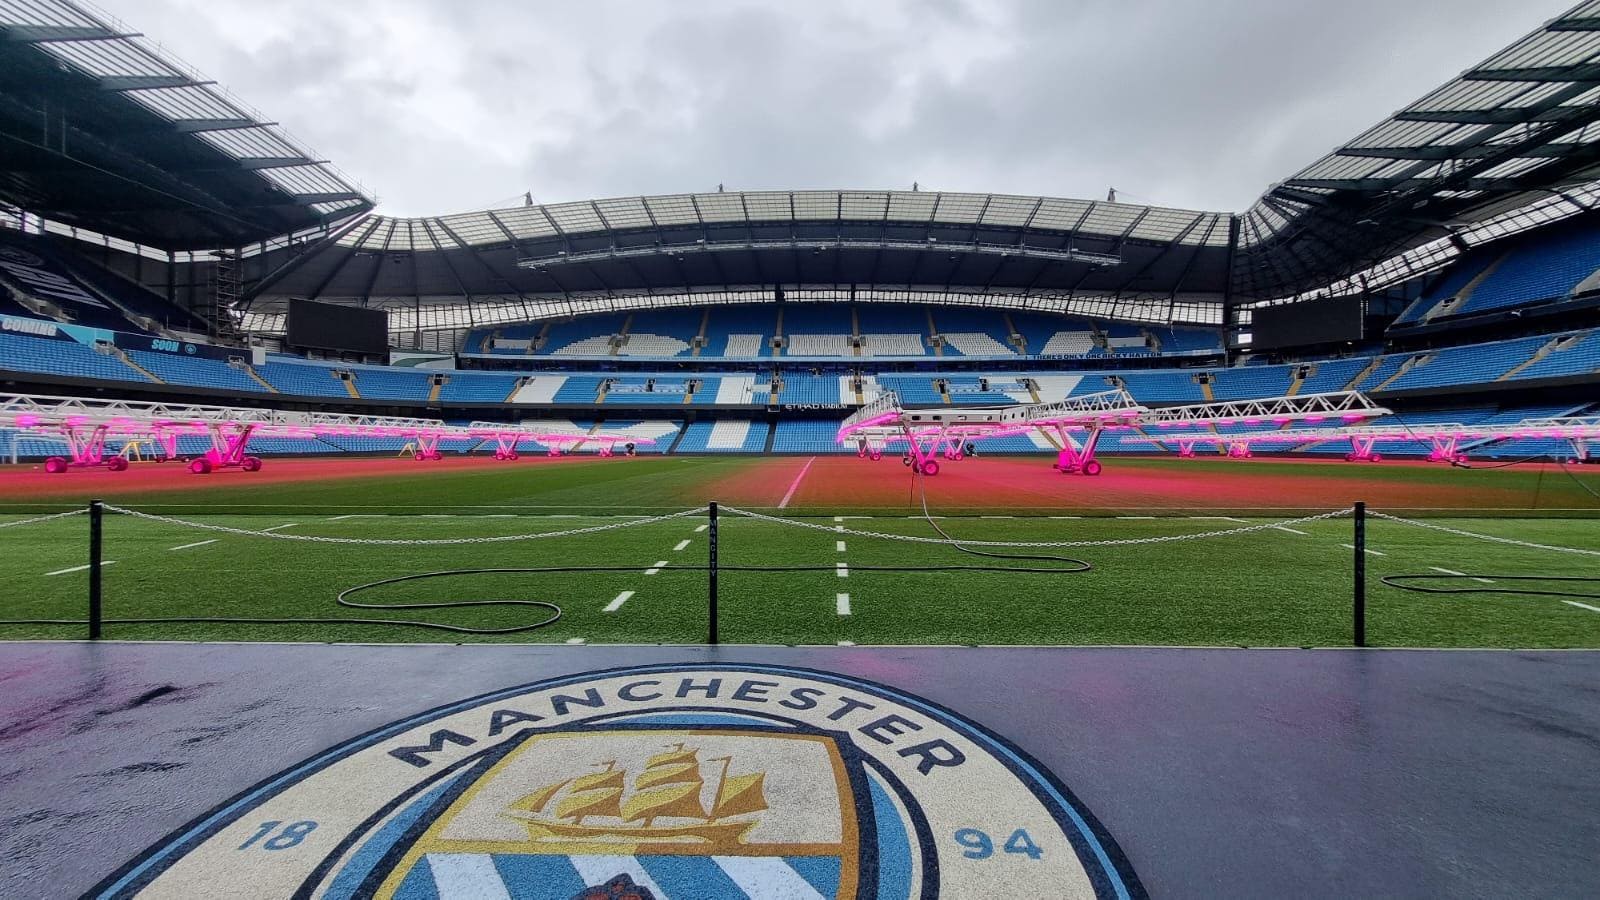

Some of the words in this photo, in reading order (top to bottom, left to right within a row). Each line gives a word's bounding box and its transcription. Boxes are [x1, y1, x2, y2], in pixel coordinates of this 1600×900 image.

[2, 318, 57, 336] COMING
[151, 339, 180, 352] SOON
[388, 677, 966, 776] MANCHESTER
[237, 820, 319, 851] 18
[954, 828, 1043, 860] 94
